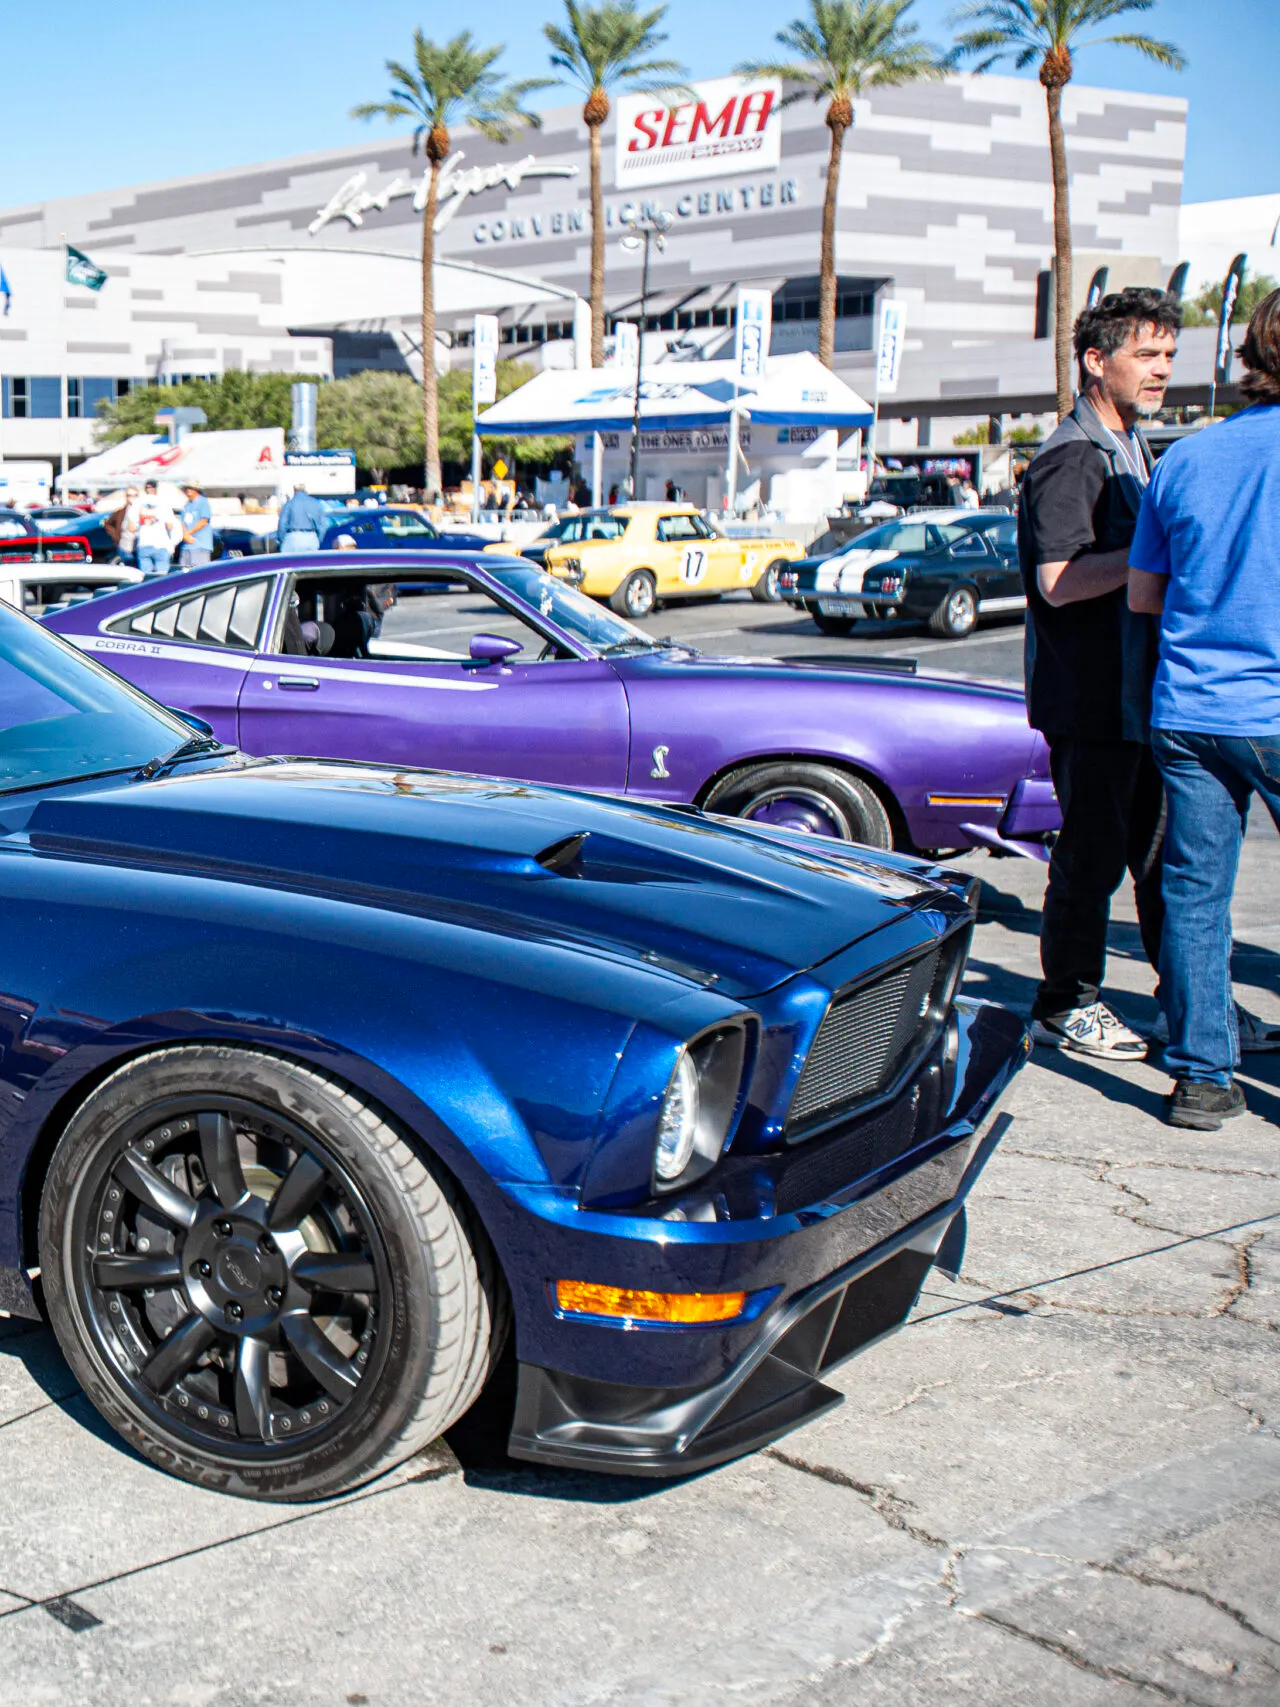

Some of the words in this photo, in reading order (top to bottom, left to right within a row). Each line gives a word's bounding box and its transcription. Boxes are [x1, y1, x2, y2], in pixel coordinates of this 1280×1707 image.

[628, 89, 775, 152] SEMA
[691, 136, 764, 160] SHOW
[473, 198, 657, 245] CONVENION
[676, 178, 798, 218] CENTER
[640, 435, 661, 449] THE
[663, 433, 693, 449] ONES
[712, 431, 752, 448] WAH
[685, 551, 705, 578] 17
[95, 639, 147, 653] COBRA
[150, 646, 163, 655] II
